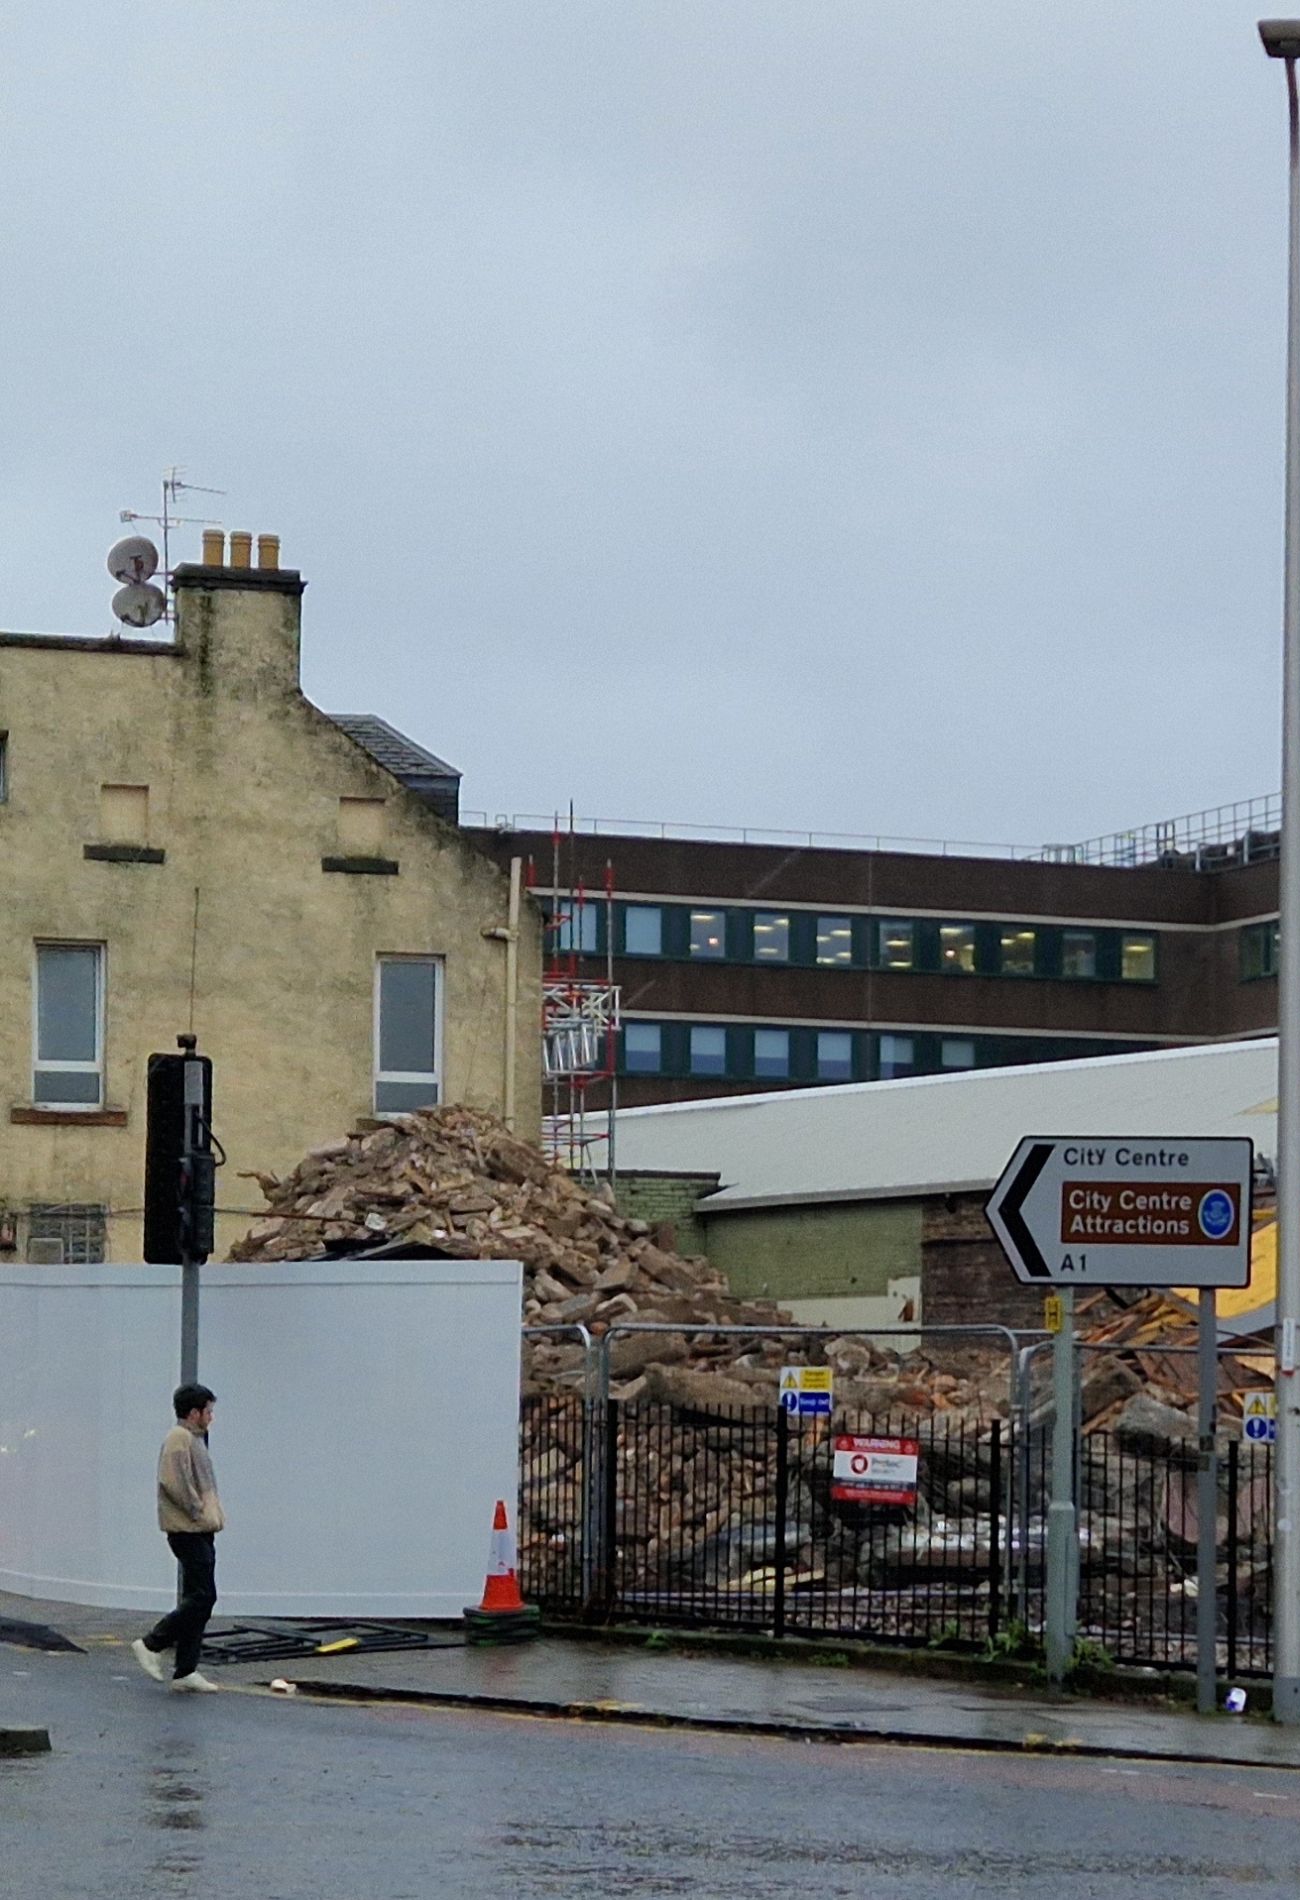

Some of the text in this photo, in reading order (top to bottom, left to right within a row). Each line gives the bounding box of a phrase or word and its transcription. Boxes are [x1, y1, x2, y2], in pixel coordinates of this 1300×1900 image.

[1063, 1147, 1190, 1167] City Centre
[1069, 1189, 1192, 1213] City Centre
[1070, 1214, 1190, 1234] Attractions
[1061, 1253, 1087, 1272] A1
[853, 1437, 901, 1450] WARNING
